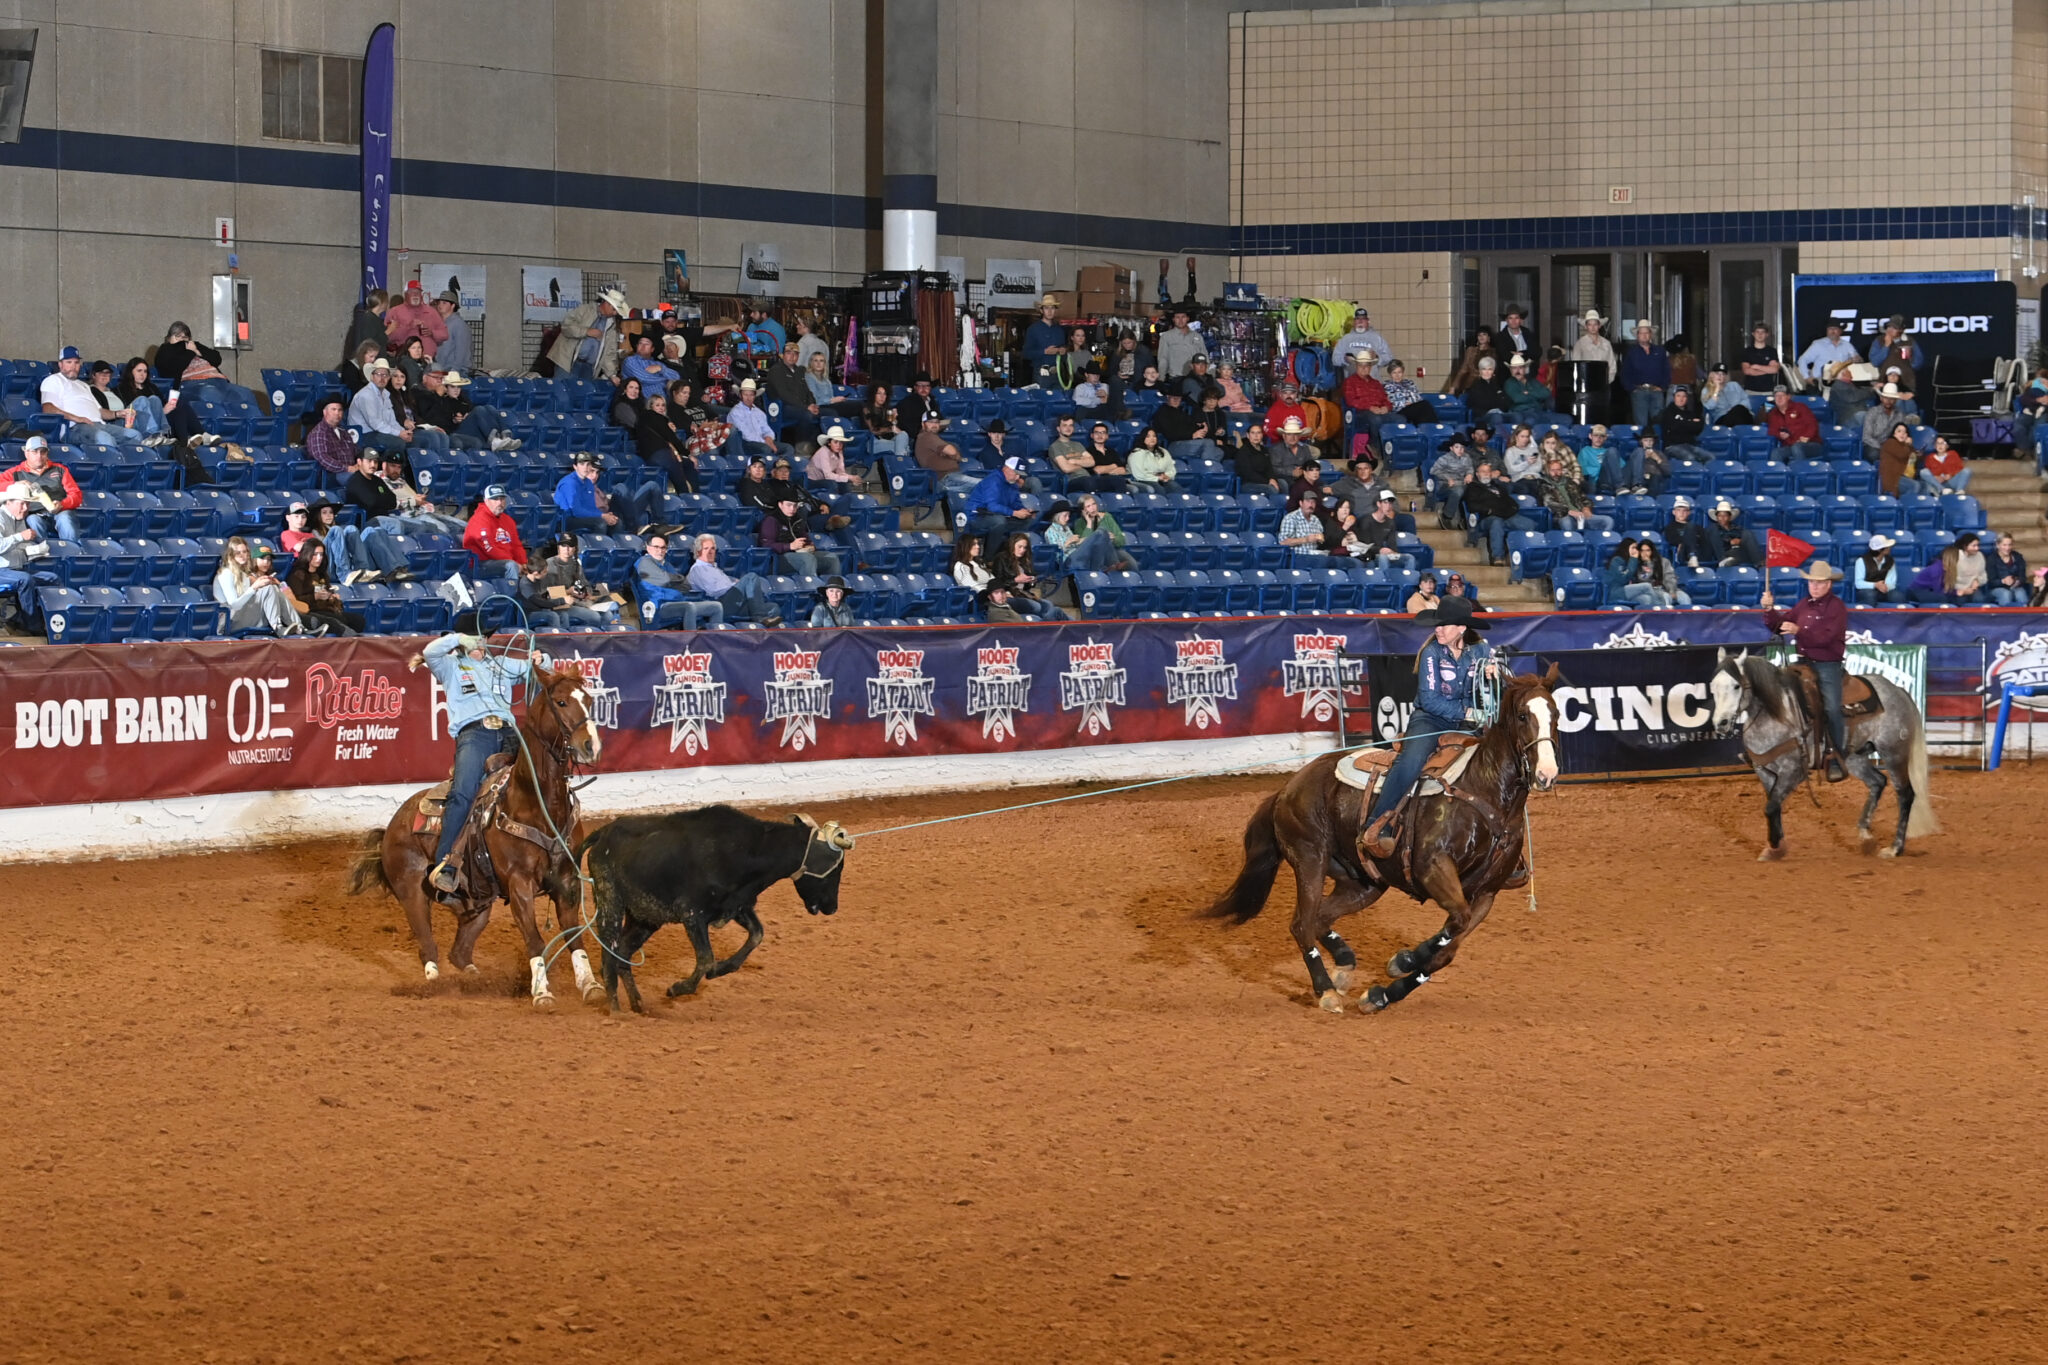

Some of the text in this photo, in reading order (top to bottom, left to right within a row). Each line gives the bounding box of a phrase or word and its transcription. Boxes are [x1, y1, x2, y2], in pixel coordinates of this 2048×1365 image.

[1613, 189, 1630, 201] EXIT
[1004, 276, 1036, 287] MARTIN
[460, 293, 484, 309] Equine
[526, 293, 581, 311] Classic Equine
[1177, 641, 1222, 656] HOOEY
[1296, 635, 1345, 650] HOOEY
[775, 652, 820, 670] HOOEY
[879, 651, 922, 668] HOOEY
[979, 648, 1018, 665] HOOEY
[1071, 645, 1113, 661] HOOEY
[664, 655, 711, 673] HOOEY
[987, 667, 1011, 676] JUNIOR
[1080, 664, 1108, 672] JUNIOR
[1188, 659, 1215, 667] JUNIOR
[675, 676, 704, 685] JUNIOR
[786, 673, 812, 682] JUNIOR
[890, 671, 913, 679] JUNIOR
[1285, 663, 1362, 693] PATROT
[1061, 670, 1126, 709] PATRIOT
[1166, 665, 1237, 703] PATRIOT
[306, 662, 402, 729] Ritchie
[765, 680, 832, 721] PATRIOT
[868, 679, 934, 717] PATRIOT
[968, 676, 1031, 714] PATRIOT
[651, 683, 725, 725] PATRIOT
[1552, 682, 1747, 732] CINC
[15, 695, 208, 749] BOOT BARN
[337, 724, 399, 741] Fresh Water
[228, 746, 293, 765] NUTRACEUTICALS
[335, 744, 351, 760] For
